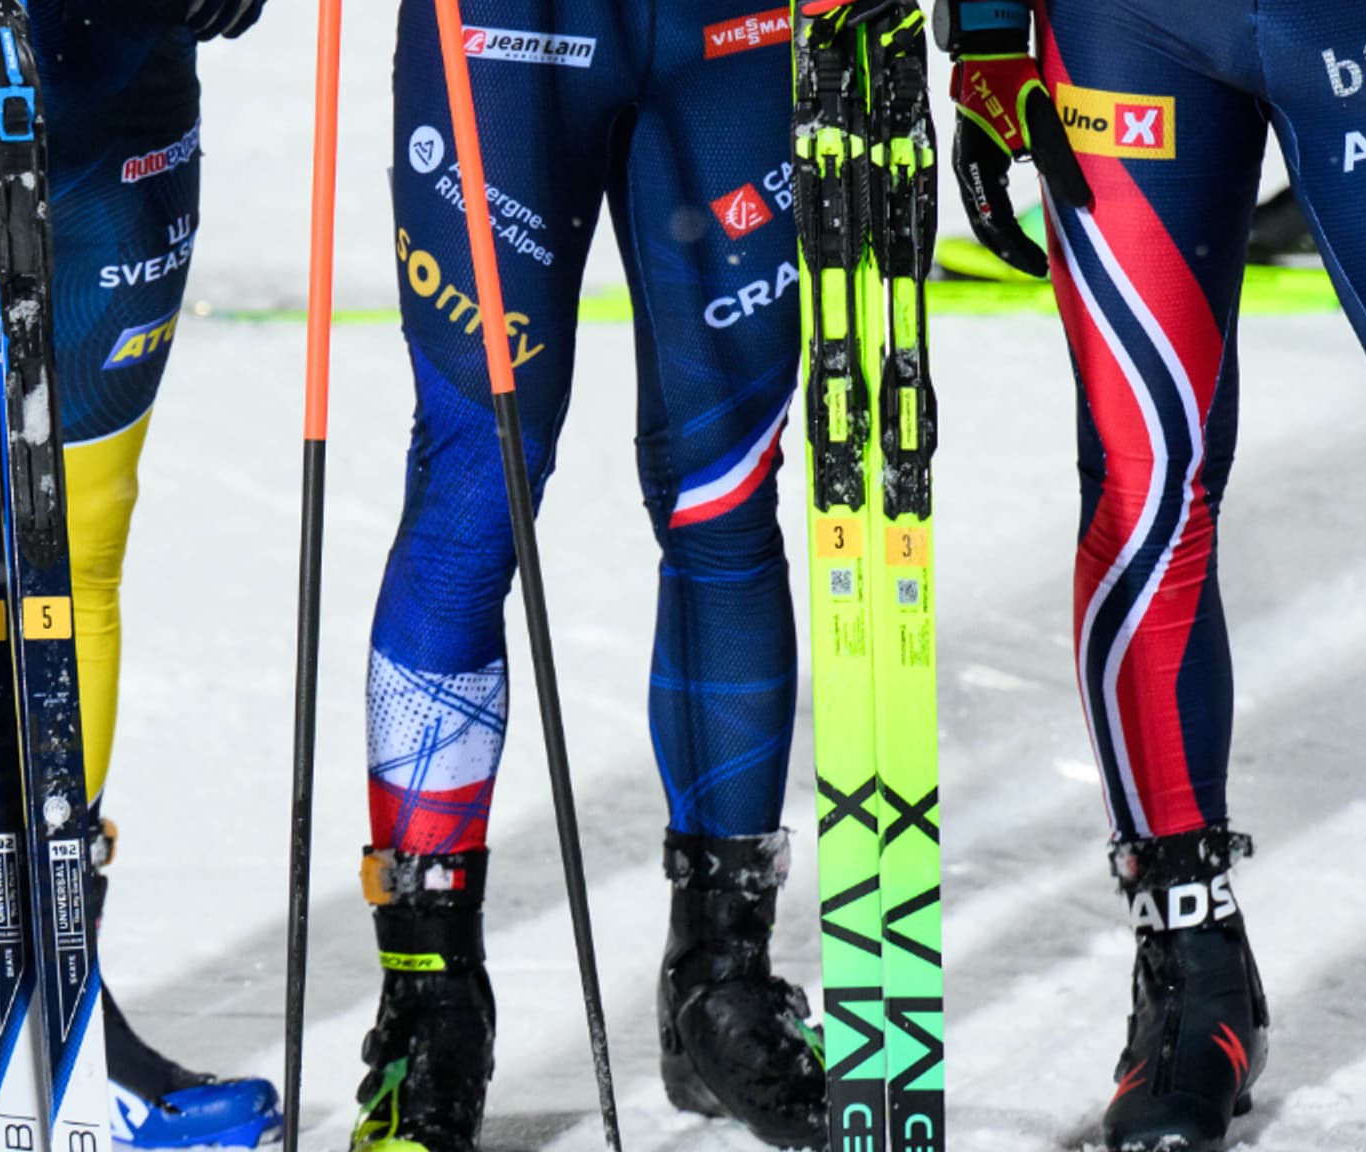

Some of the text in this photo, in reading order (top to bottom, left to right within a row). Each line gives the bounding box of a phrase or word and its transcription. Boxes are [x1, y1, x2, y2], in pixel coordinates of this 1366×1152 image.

[486, 34, 540, 53] Jean
[543, 38, 593, 58] Lain
[969, 70, 1018, 140] LEKI
[1063, 105, 1109, 133] Uno
[704, 260, 799, 330] CRA
[834, 525, 845, 550] 3
[902, 534, 913, 558] 3
[41, 605, 53, 630] 5
[51, 846, 78, 856] 192
[55, 863, 68, 930] UNIVERSAL
